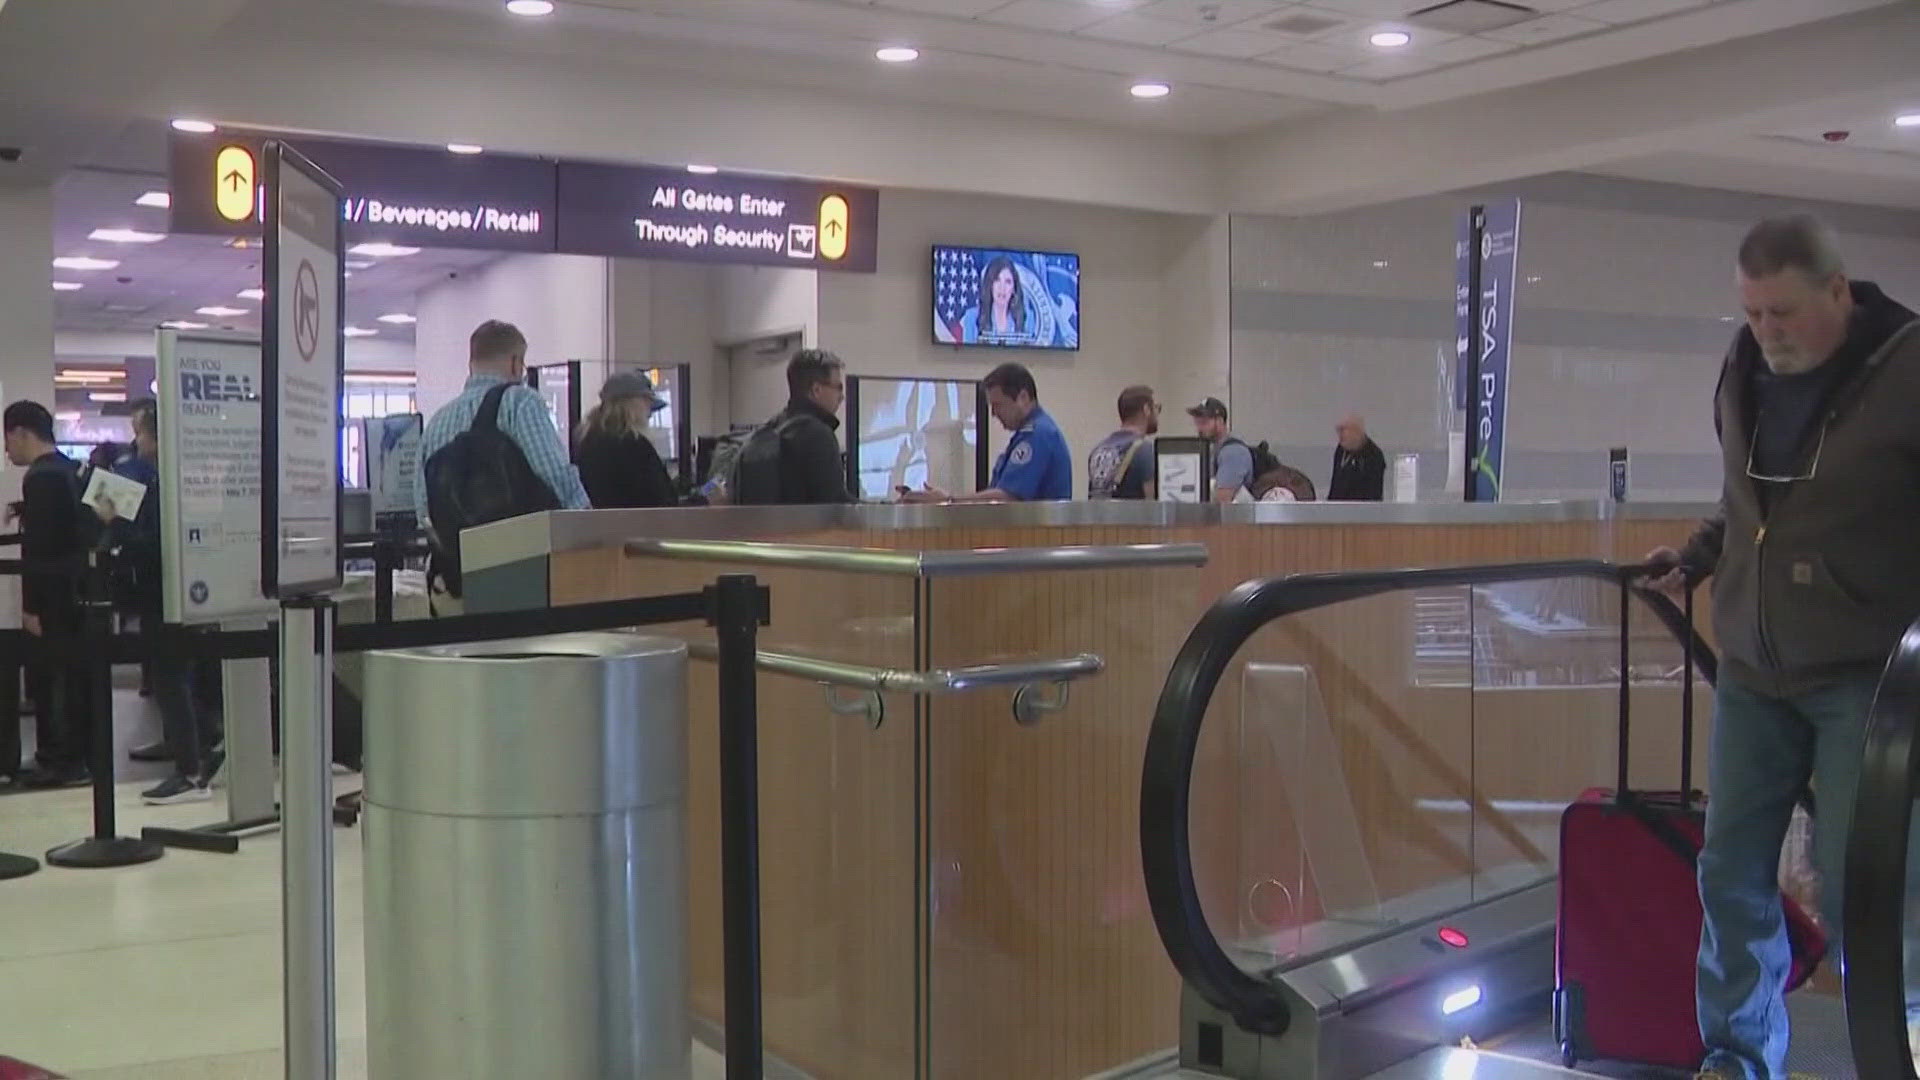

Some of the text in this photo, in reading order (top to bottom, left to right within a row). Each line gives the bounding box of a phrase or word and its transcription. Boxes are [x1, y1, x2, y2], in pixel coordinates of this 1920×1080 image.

[652, 186, 785, 217] All Gates Enter
[635, 219, 784, 253] Through Security
[1481, 278, 1498, 362] TSA
[181, 372, 260, 401] REAL
